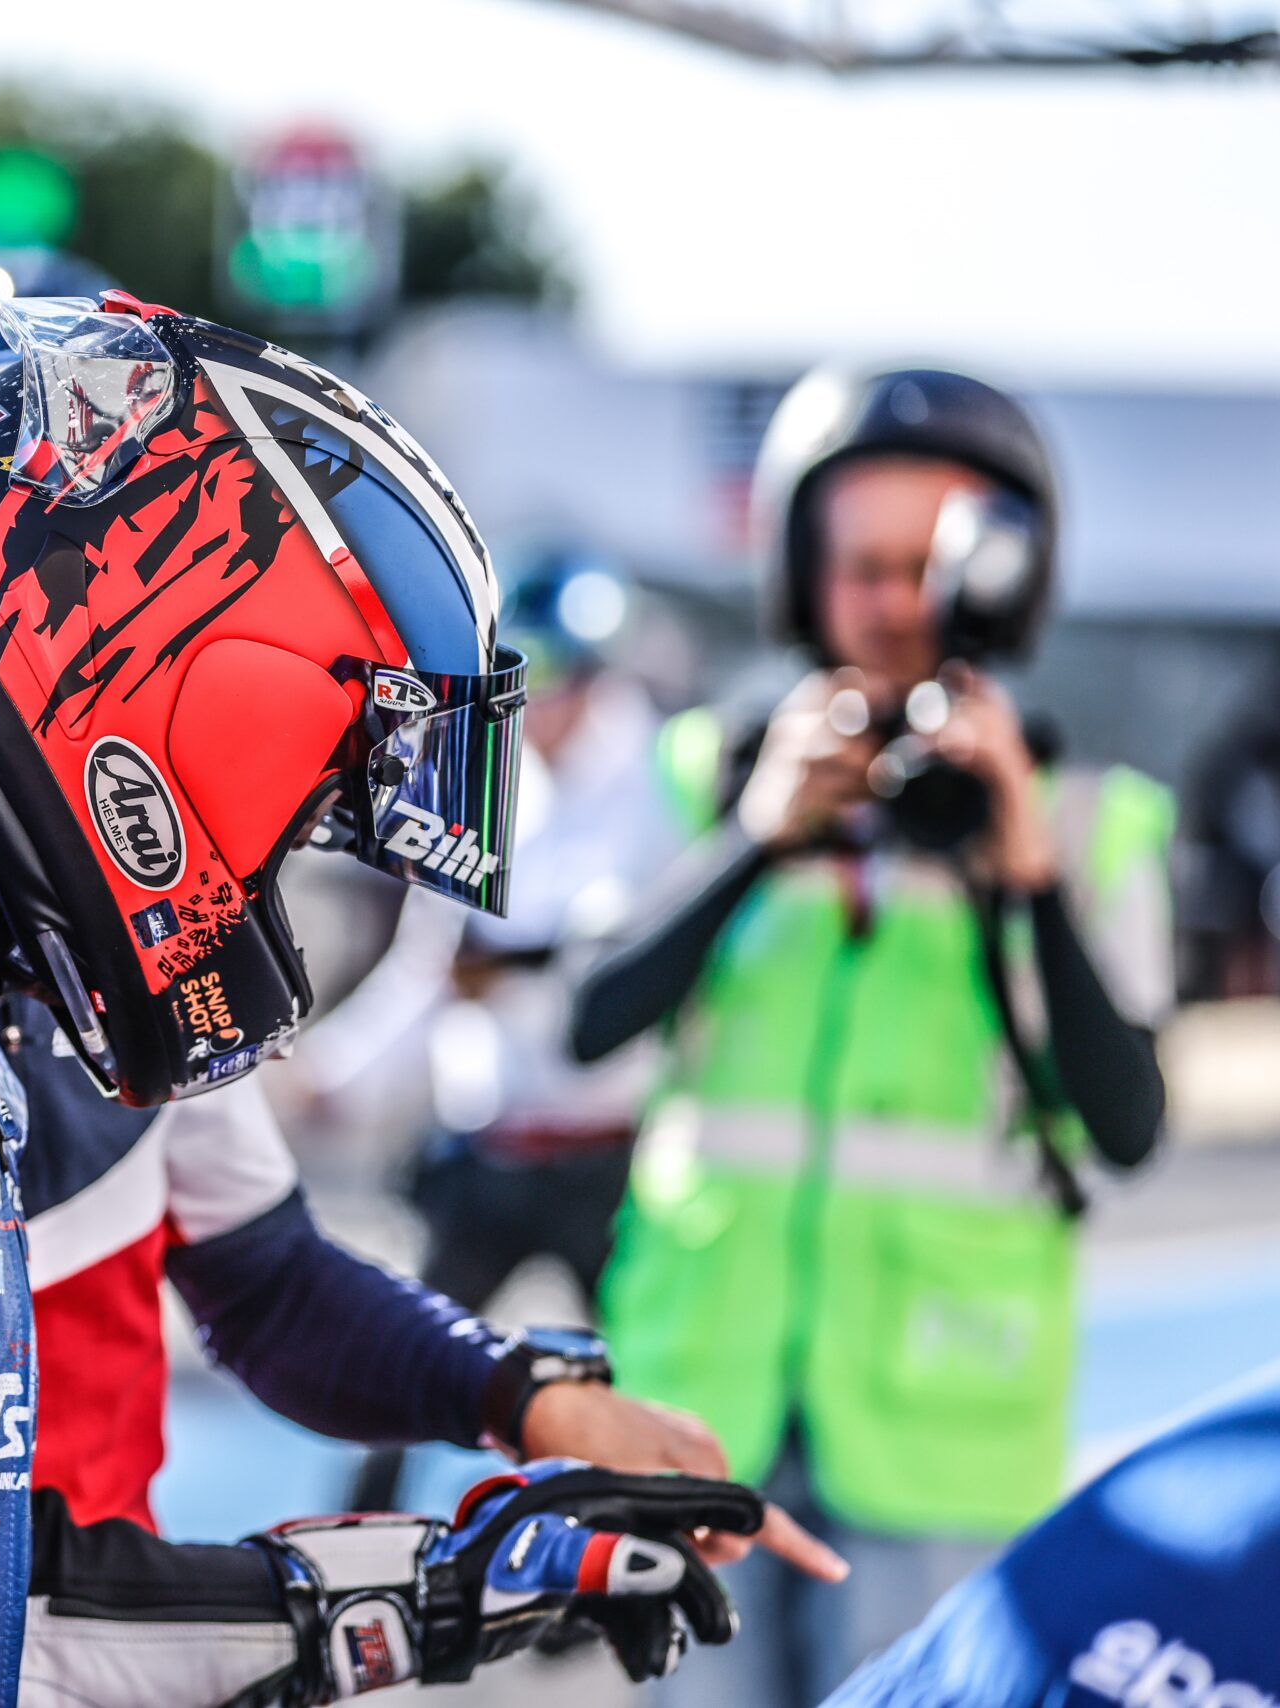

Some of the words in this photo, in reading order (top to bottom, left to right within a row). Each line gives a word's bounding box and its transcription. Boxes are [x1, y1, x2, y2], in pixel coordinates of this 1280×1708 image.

[377, 679, 429, 707] R75
[94, 757, 179, 871] Arai
[98, 798, 129, 853] HELMET
[383, 799, 499, 888] Bihr
[180, 978, 213, 1034] SHOT
